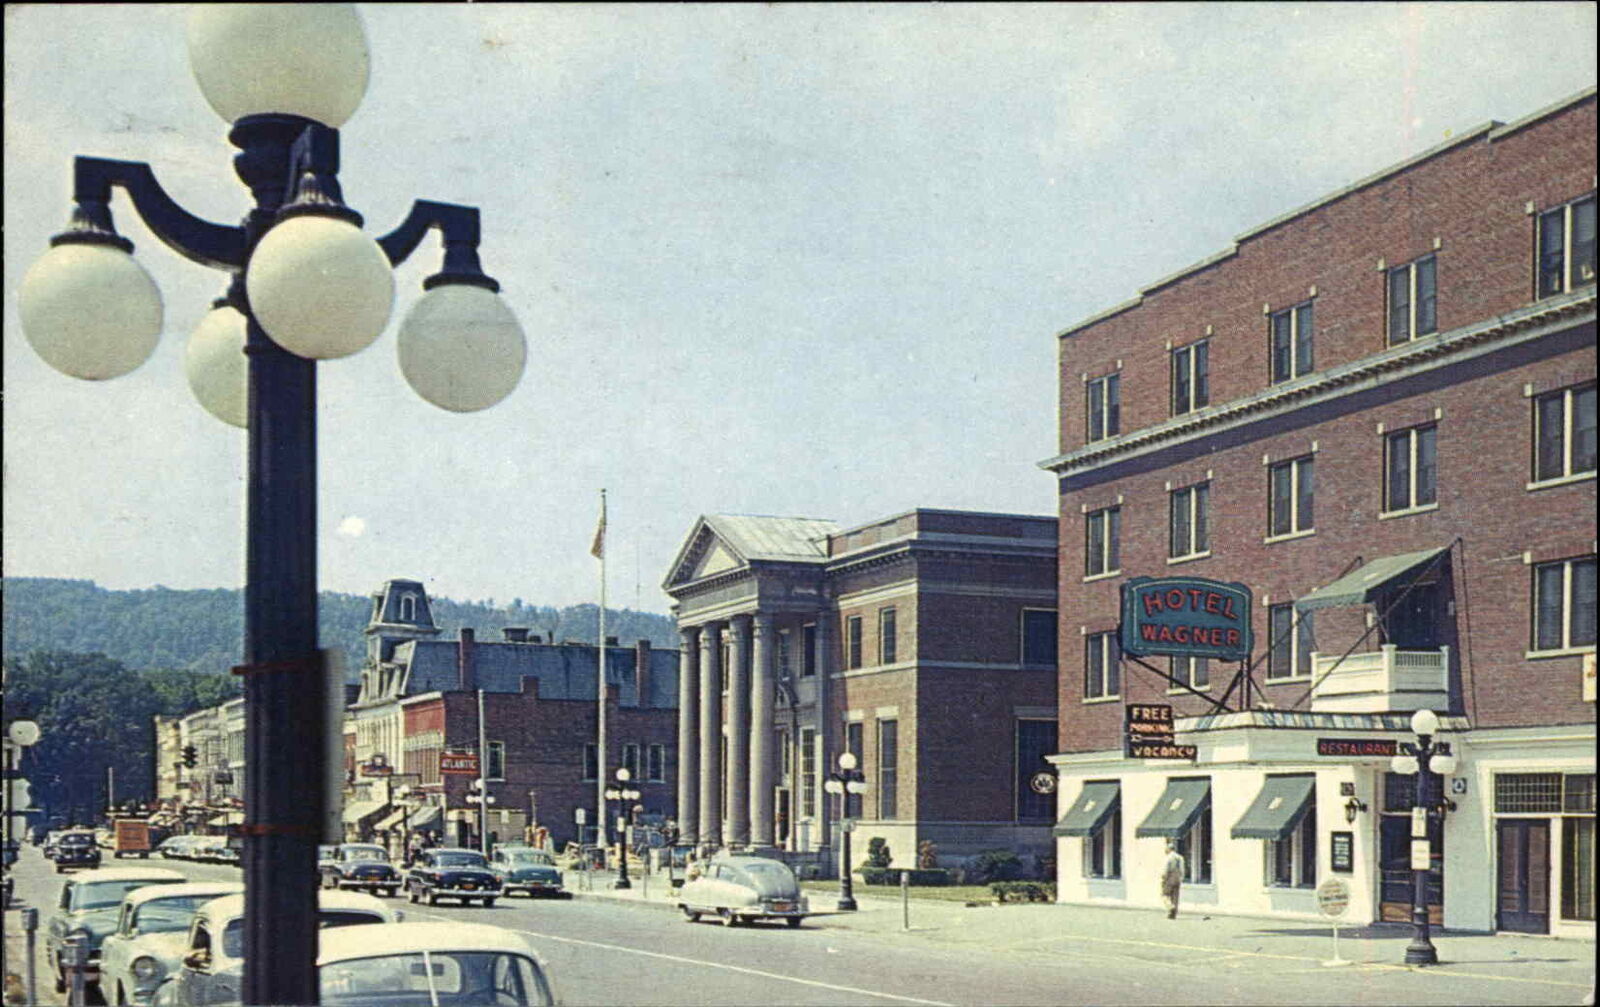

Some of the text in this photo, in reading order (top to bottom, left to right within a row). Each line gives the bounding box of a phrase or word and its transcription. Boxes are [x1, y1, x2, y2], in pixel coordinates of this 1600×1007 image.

[1143, 589, 1238, 620] HOTEL
[1142, 624, 1240, 646] WAGNER
[1132, 707, 1169, 720] FREE
[1319, 743, 1396, 756] RESTAURANT
[441, 759, 477, 769] ATLANTIC
